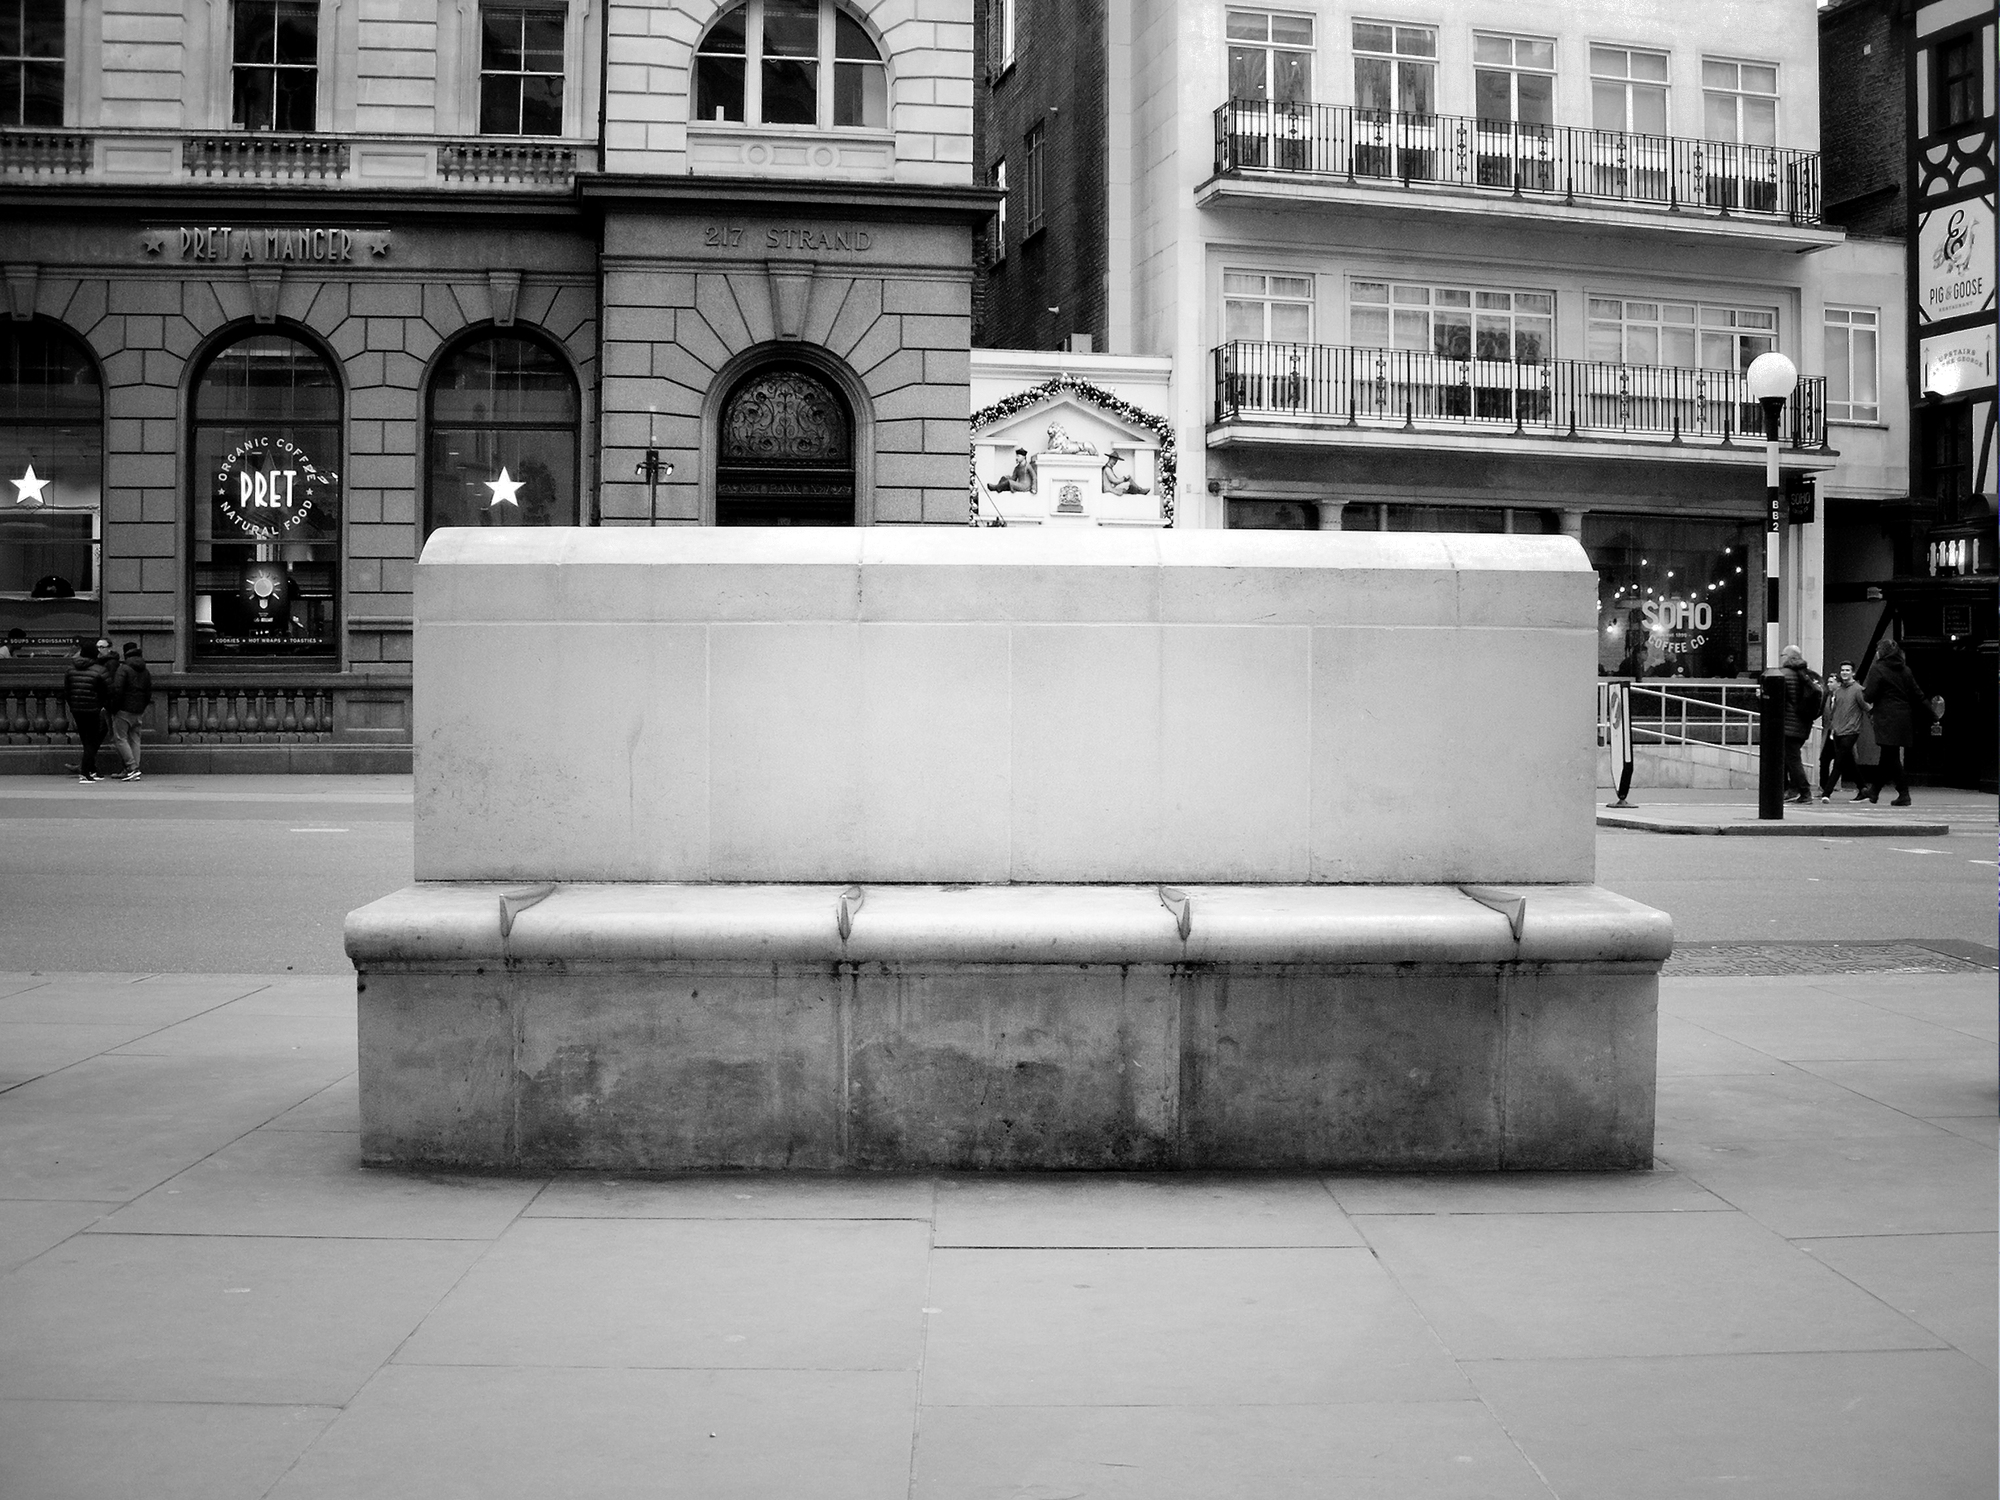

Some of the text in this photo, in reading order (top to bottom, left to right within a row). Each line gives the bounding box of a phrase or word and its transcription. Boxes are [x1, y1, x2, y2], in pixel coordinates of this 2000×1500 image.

[180, 226, 352, 261] PRET A MANGER
[705, 226, 873, 251] 217 STRAND
[1929, 286, 1944, 306] PIG
[1953, 277, 1983, 300] GOOSE
[1938, 300, 1974, 313] RESTAURANT
[1938, 348, 1977, 363] UPSTAIRS
[218, 436, 269, 482] ORGANIC
[240, 470, 297, 508] PRET
[220, 500, 313, 537] NATURAL FOOD
[1641, 600, 1712, 631] SOHO
[1647, 634, 1688, 654] COFFEE
